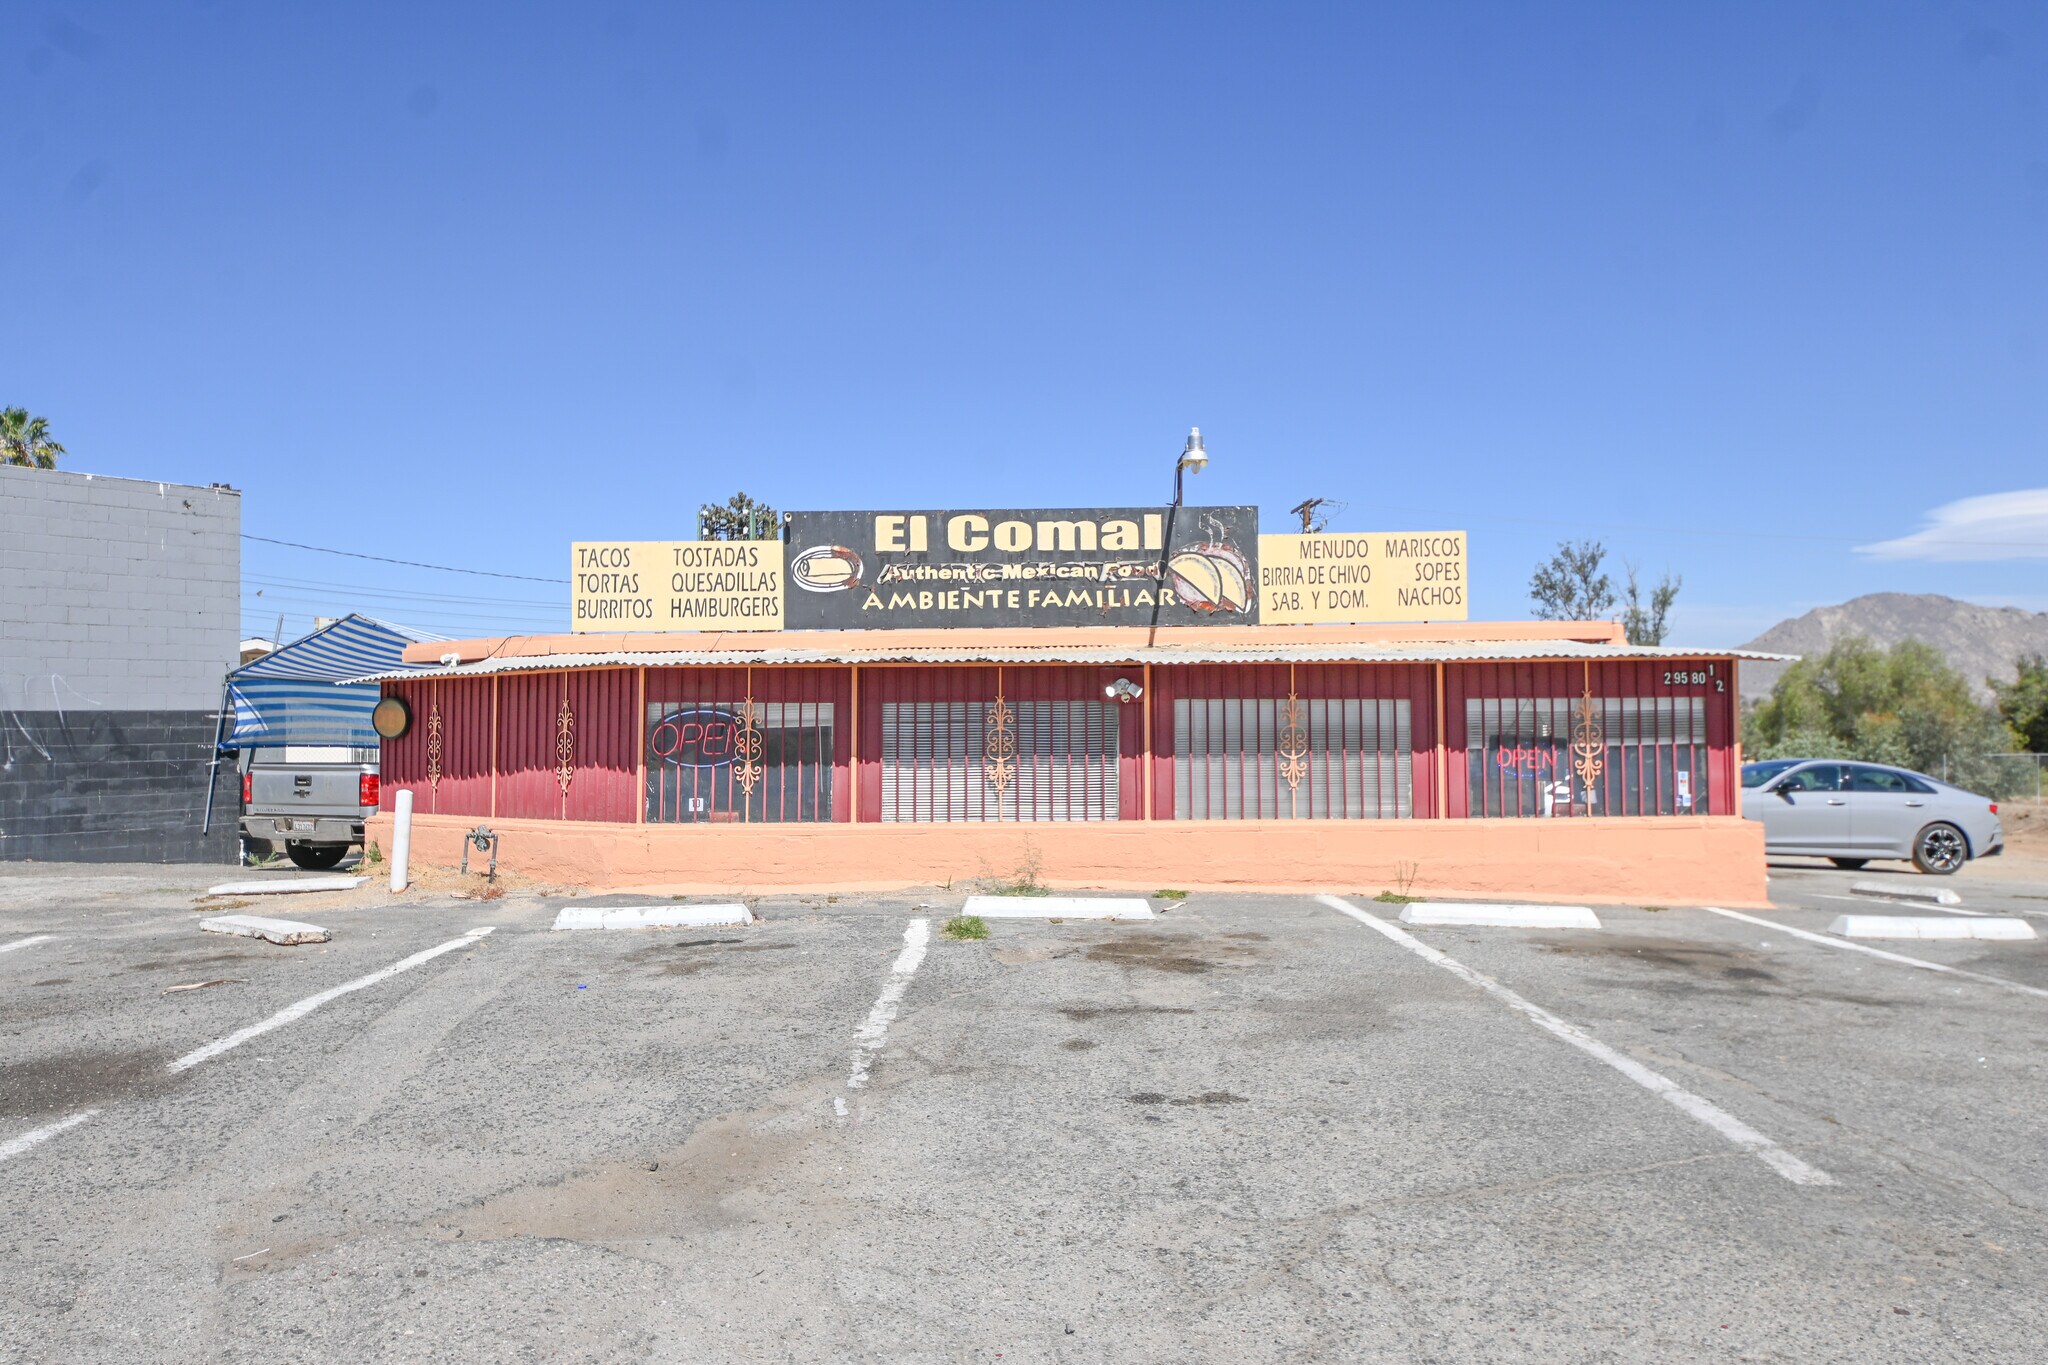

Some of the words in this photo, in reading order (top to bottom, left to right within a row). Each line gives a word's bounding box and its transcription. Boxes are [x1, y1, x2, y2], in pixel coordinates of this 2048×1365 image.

[875, 515, 928, 552] El
[947, 513, 1163, 552] Comal
[578, 547, 630, 568] TACOS
[673, 546, 758, 567] TOSTADAS
[1300, 539, 1369, 559] MENUDO
[1385, 538, 1460, 558] MARISCOS
[672, 571, 777, 593] QUESADILLAS
[887, 564, 997, 581] Authentic
[1003, 563, 1099, 579] Mexican
[1263, 567, 1305, 586] BIRRIA
[1308, 566, 1325, 585] DE
[1329, 565, 1371, 584] CHIVO
[1415, 562, 1460, 581] SOPES
[578, 573, 639, 593] TORTAS
[862, 590, 1020, 610] AMBIENTE
[1028, 588, 1176, 608] FAMILIAR
[1272, 592, 1304, 611] SAB.
[1312, 591, 1321, 610] Y
[1329, 589, 1369, 609] DOM.
[1398, 586, 1462, 606] NACHOS
[577, 598, 653, 619] BURRITOS
[671, 597, 779, 618] HAMBURGERS
[652, 723, 747, 756] OPEN
[1497, 748, 1557, 769] OPEN
